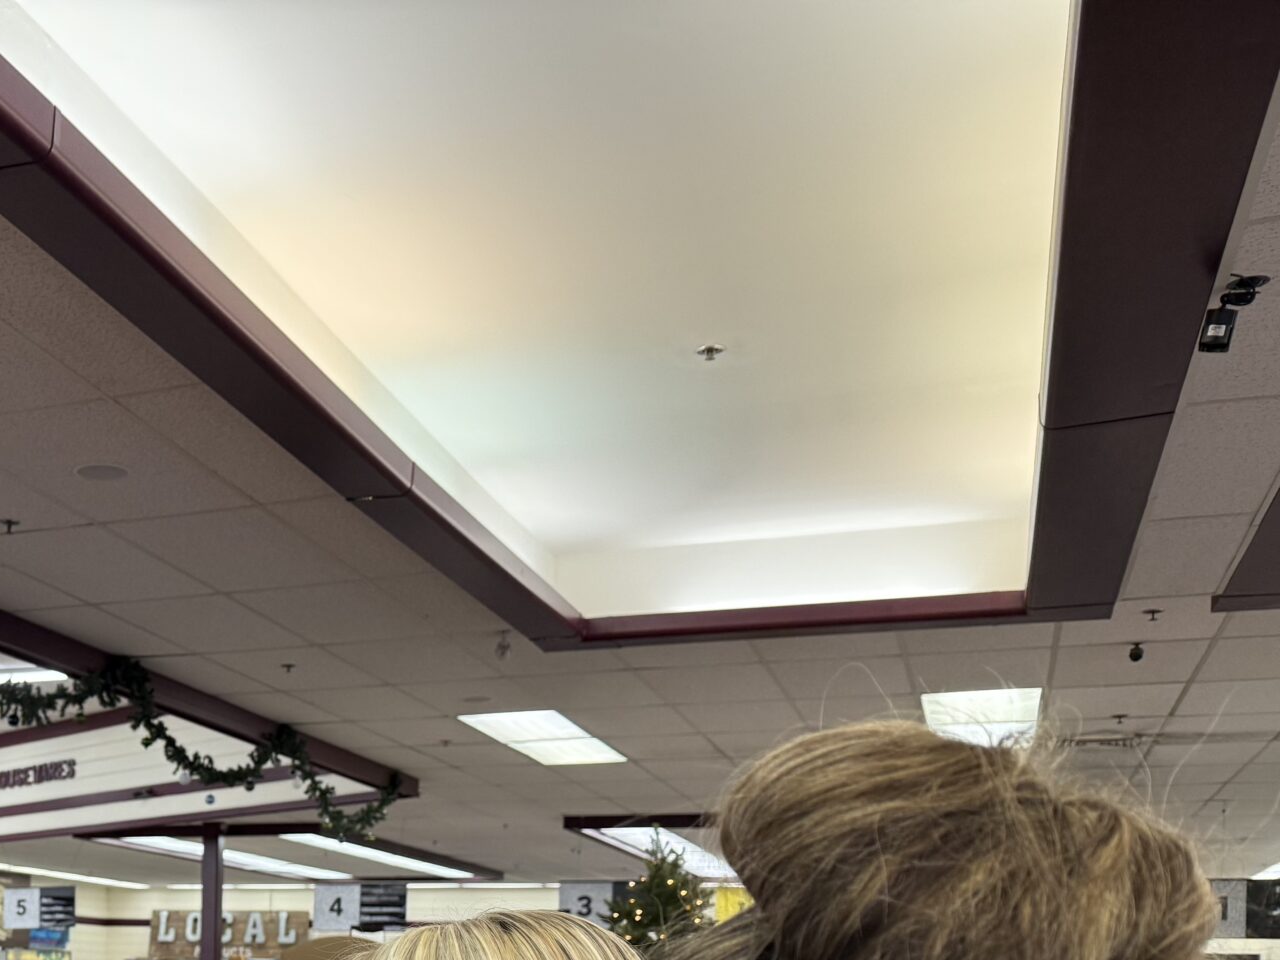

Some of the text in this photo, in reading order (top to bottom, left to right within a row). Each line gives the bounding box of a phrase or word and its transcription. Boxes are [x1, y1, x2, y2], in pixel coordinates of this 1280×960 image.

[16, 899, 26, 916] 5
[329, 897, 344, 917] 4
[577, 896, 592, 916] 3
[157, 911, 296, 945] LOCAL
